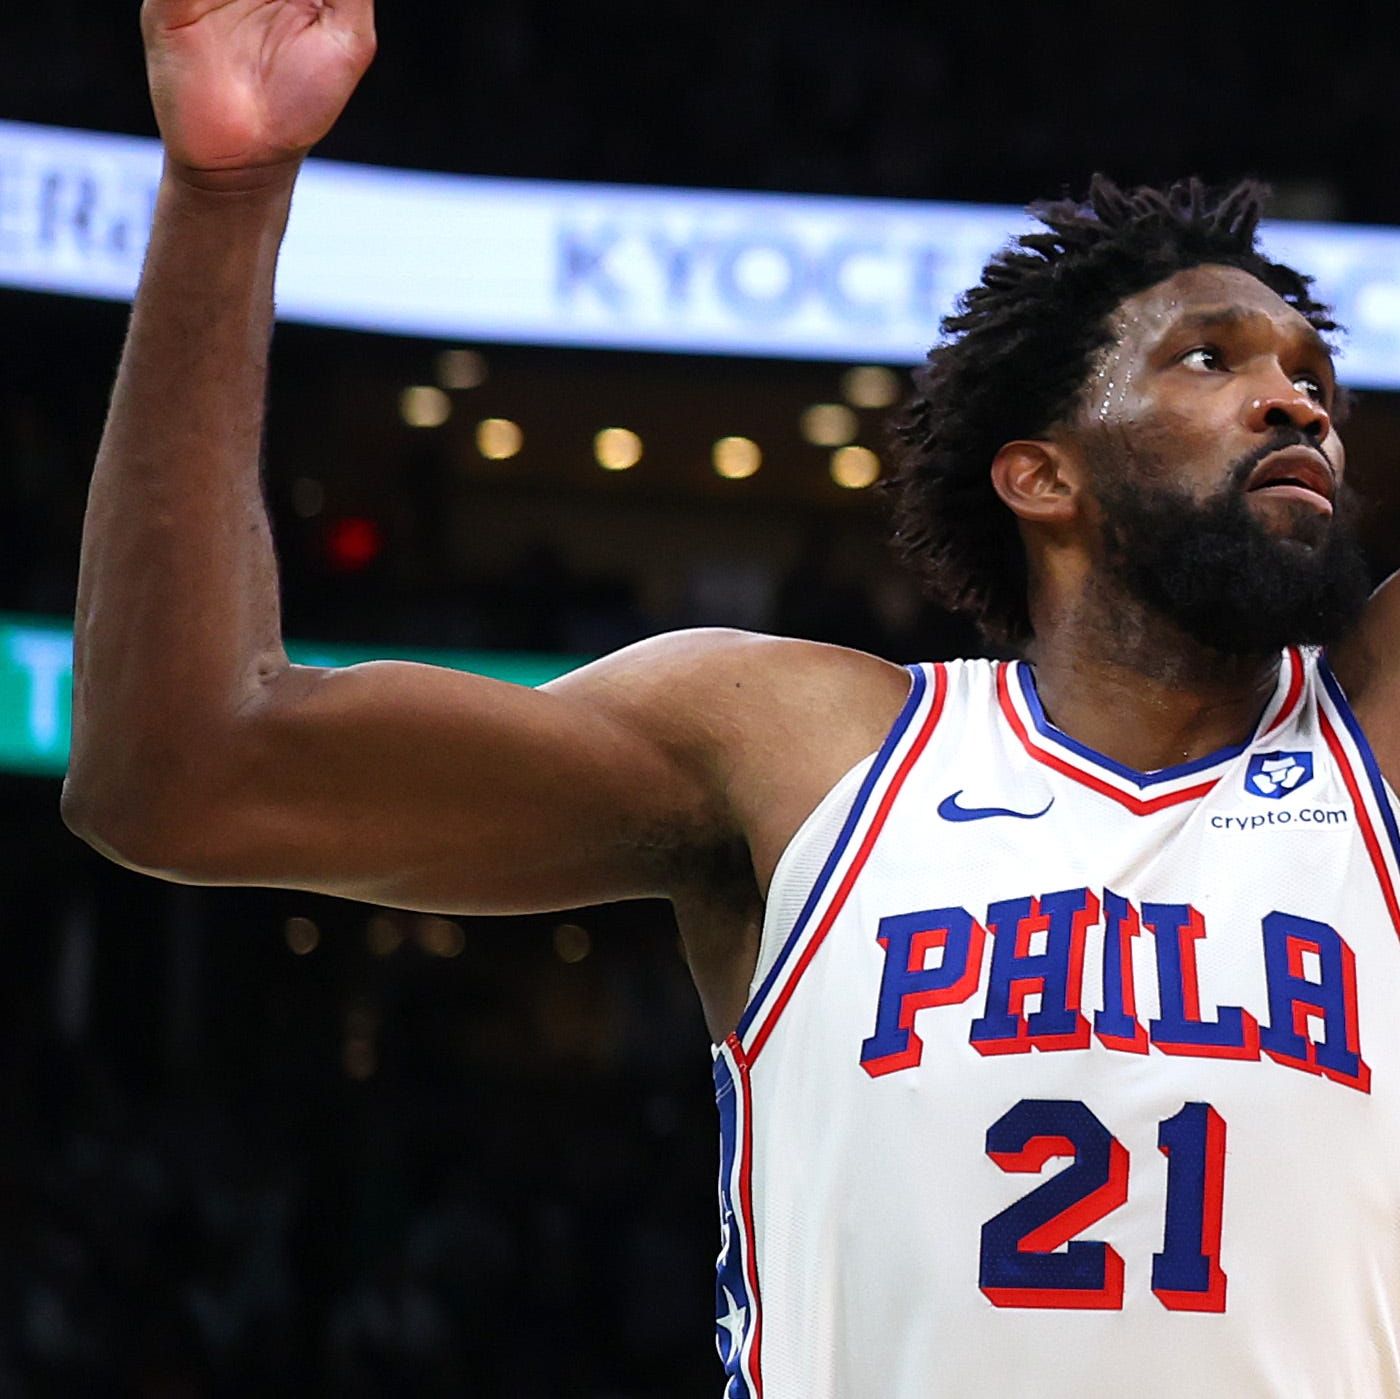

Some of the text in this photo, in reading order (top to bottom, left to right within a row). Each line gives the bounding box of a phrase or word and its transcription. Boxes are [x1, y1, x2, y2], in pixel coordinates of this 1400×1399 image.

[1211, 809, 1348, 830] crypto.com
[860, 887, 1371, 1094] PHILA
[979, 1099, 1227, 1312] 21
